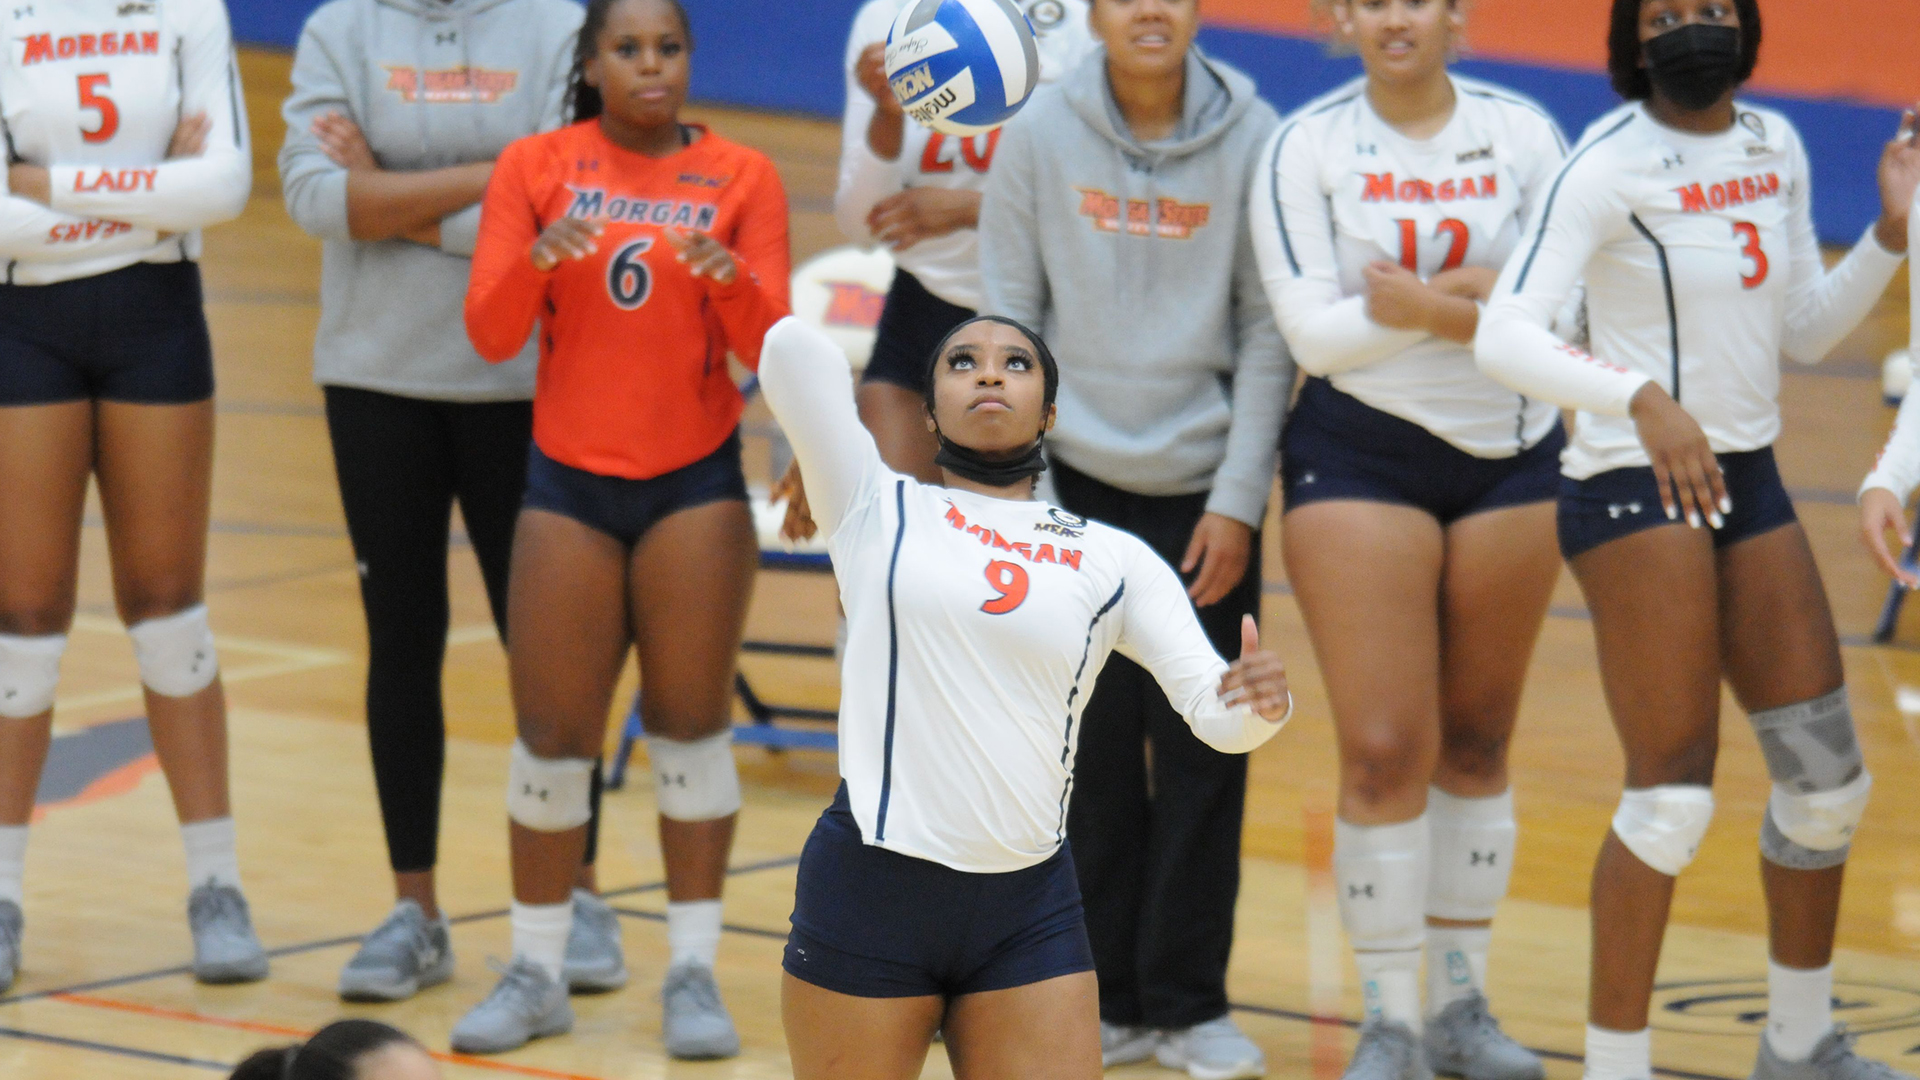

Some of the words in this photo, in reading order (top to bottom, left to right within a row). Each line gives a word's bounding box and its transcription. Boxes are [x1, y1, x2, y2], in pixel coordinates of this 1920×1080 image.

[15, 32, 159, 66] MORGAN
[77, 73, 119, 144] 5
[909, 87, 957, 121] molte
[73, 168, 158, 193] LADY
[1354, 171, 1497, 204] MORGAN
[1669, 172, 1780, 213] MORGAN
[565, 183, 718, 233] MORGAN
[1391, 217, 1470, 274] 12
[1732, 221, 1769, 289] 3
[605, 236, 655, 311] 6
[978, 558, 1030, 616] 9
